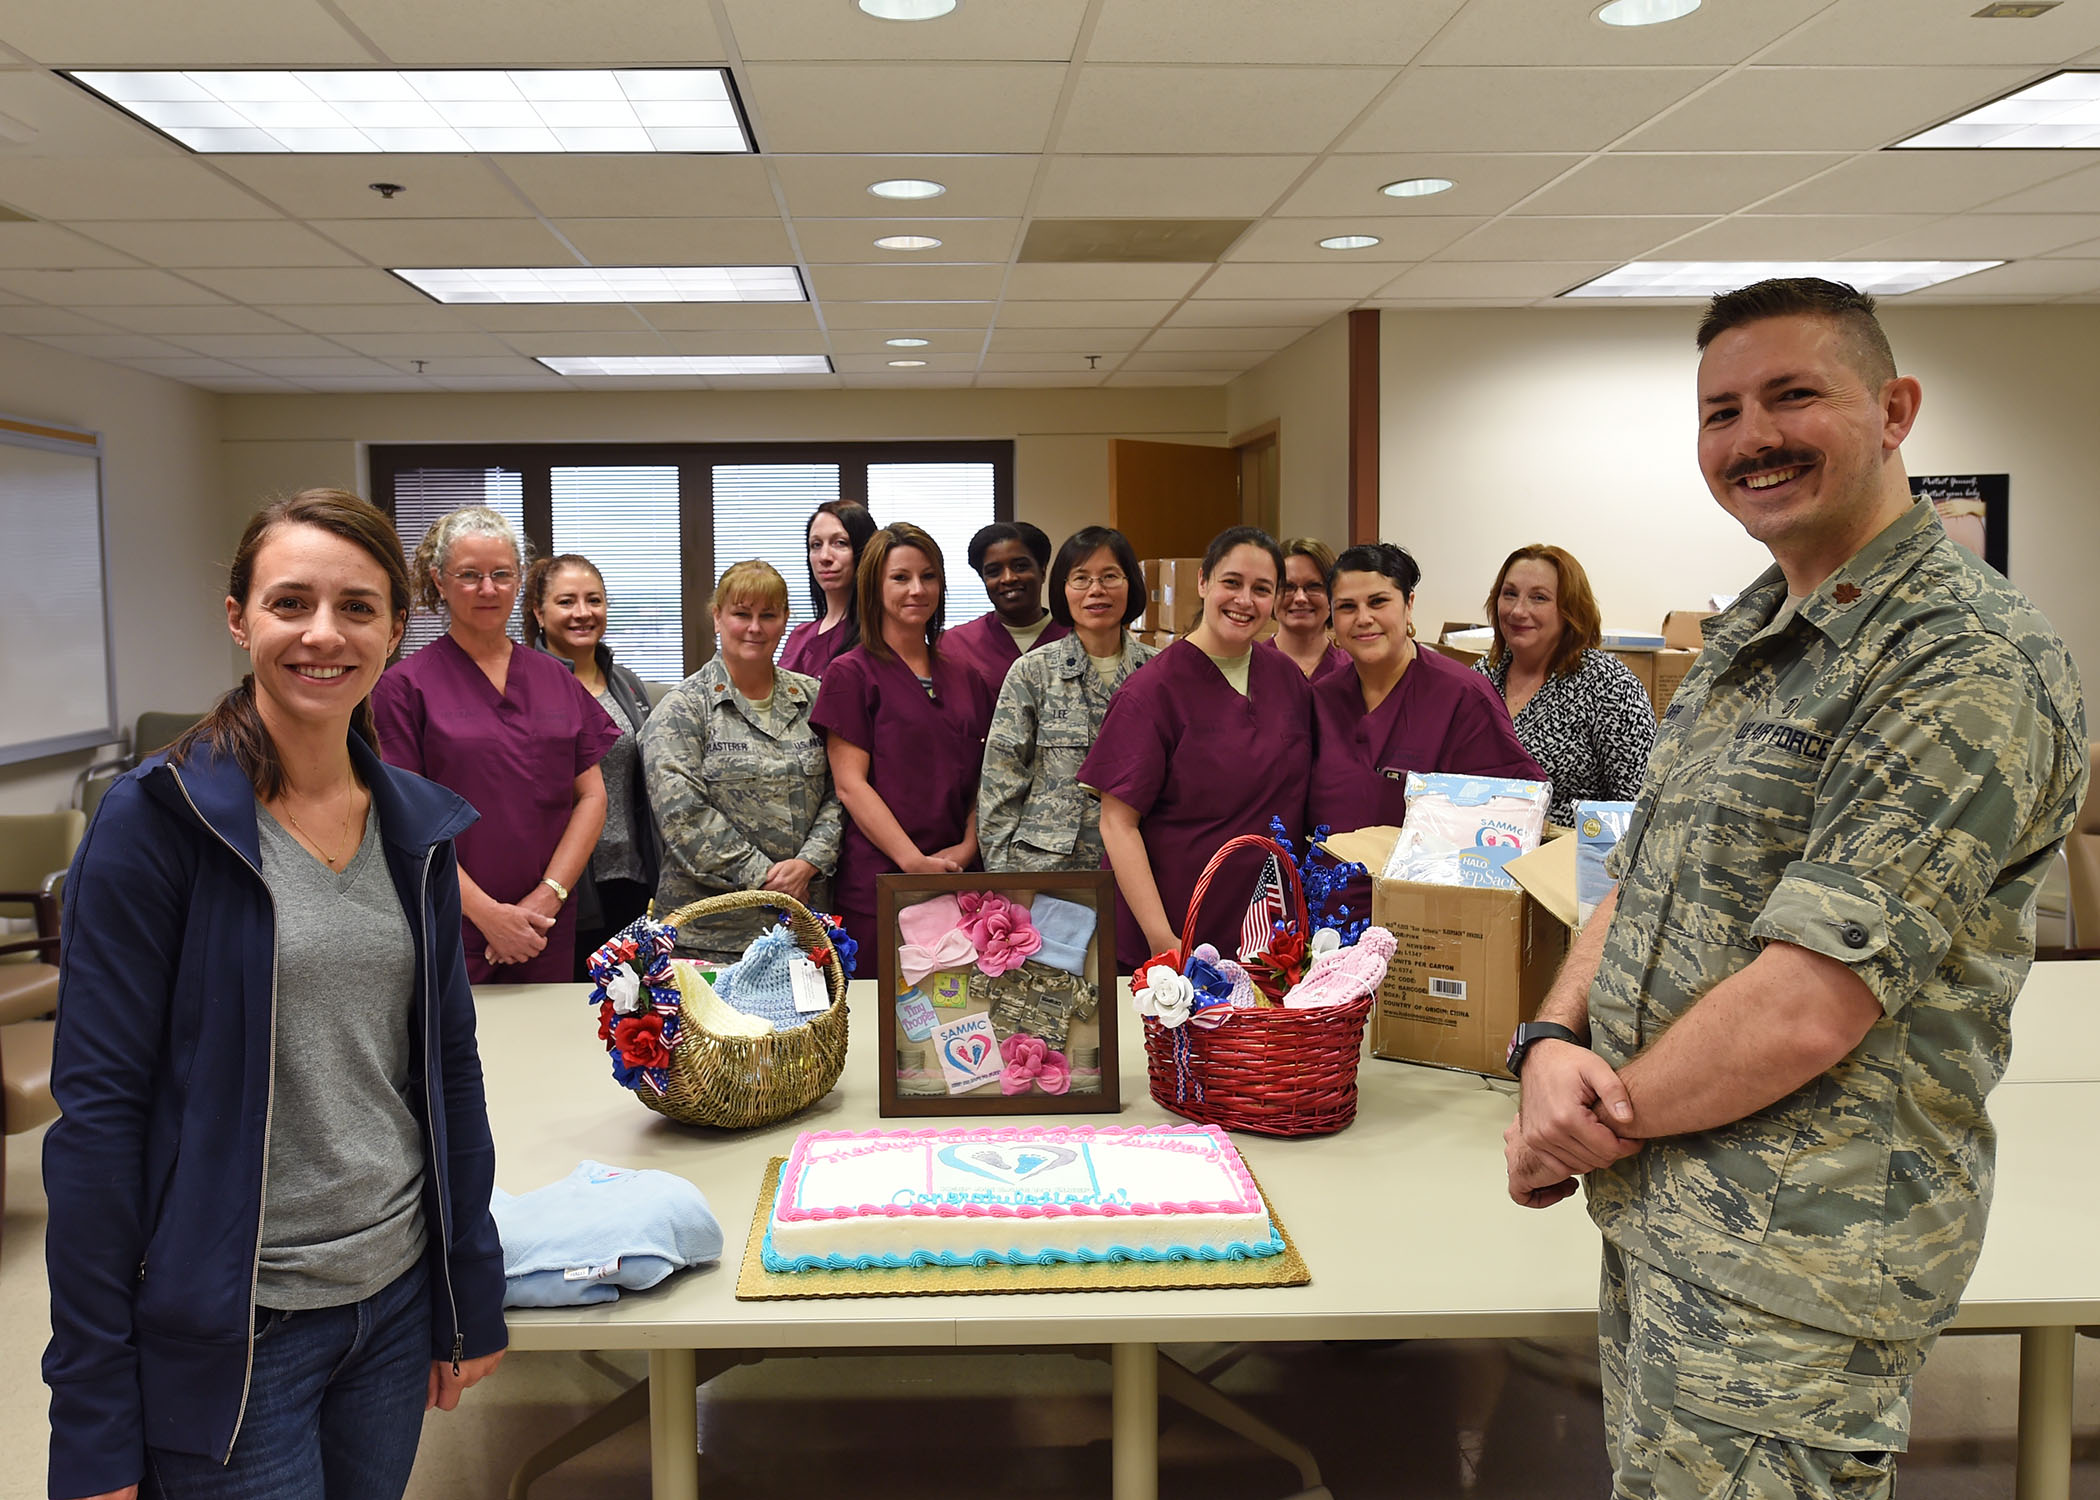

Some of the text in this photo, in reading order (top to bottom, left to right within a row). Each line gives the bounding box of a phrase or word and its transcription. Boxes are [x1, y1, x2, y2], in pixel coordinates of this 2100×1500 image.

[1965, 488, 1980, 500] baby
[1053, 709, 1069, 720] LEE
[1768, 725, 1835, 761] FORCE
[1480, 818, 1525, 837] SAMMC
[1462, 857, 1488, 869] HALO
[1393, 957, 1455, 972] UNITS PER CARTON
[1383, 982, 1396, 990] UPC
[1398, 976, 1417, 984] CODE:
[903, 1002, 926, 1018] Tiny
[1383, 999, 1411, 1009] COUNTRY
[1449, 1009, 1470, 1018] CHINA
[901, 1011, 936, 1032] Trooper
[940, 1020, 987, 1041] SAMMC
